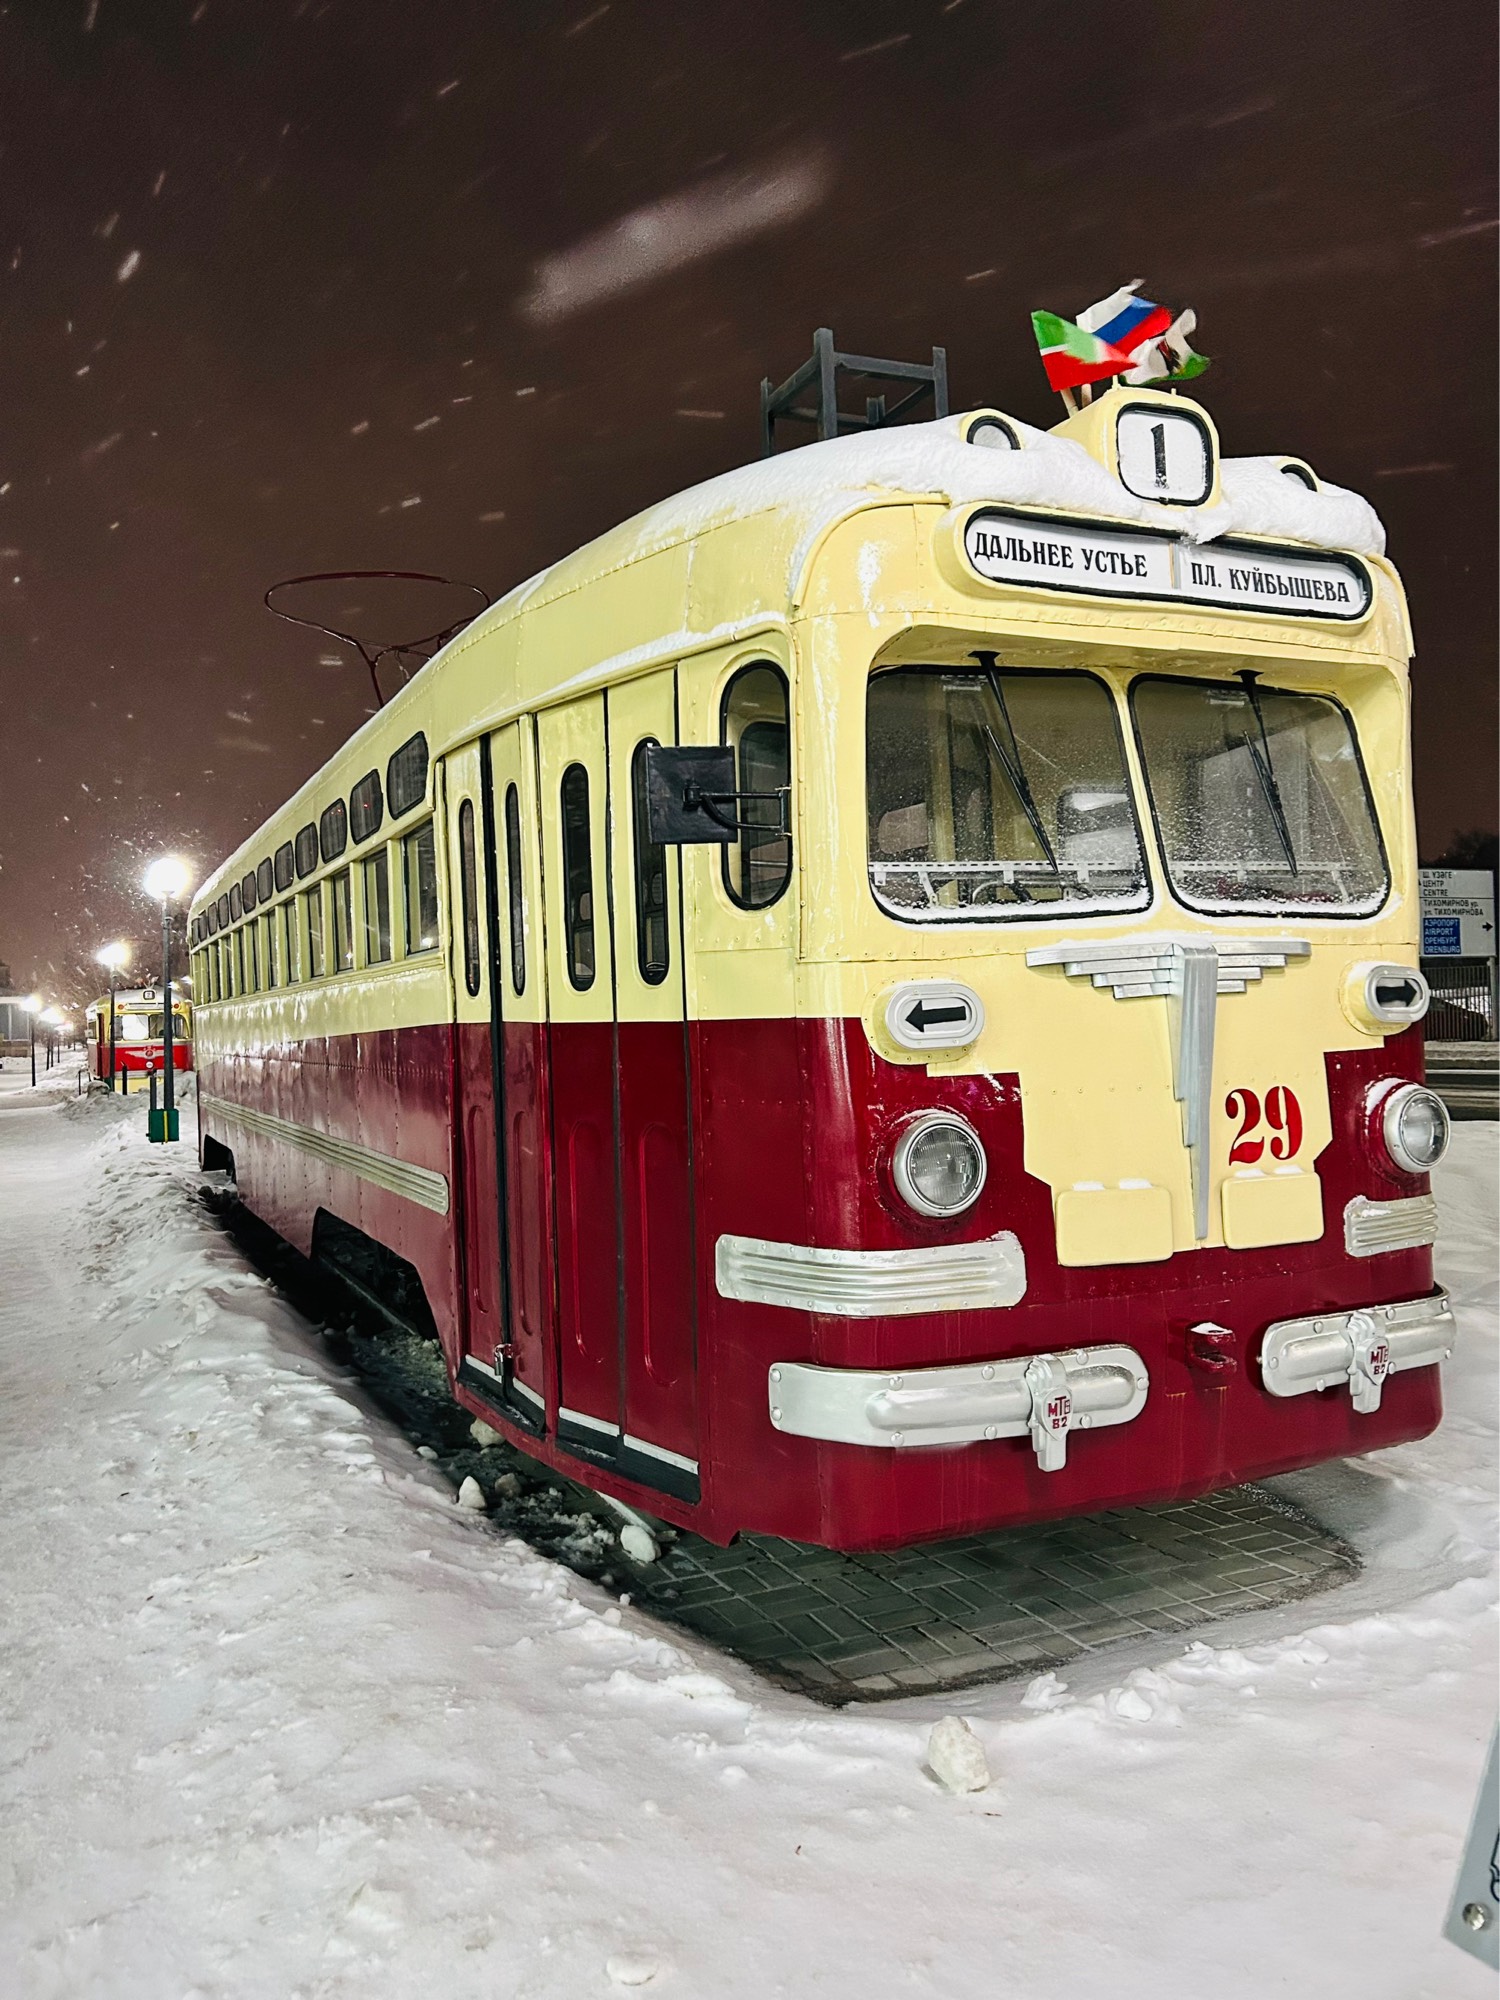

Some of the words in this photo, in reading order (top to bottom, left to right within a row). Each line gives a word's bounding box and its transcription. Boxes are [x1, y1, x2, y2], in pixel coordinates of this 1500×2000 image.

[1150, 423, 1169, 489] 1
[974, 532, 1074, 569] ДАЛЬНЕЕ
[1081, 548, 1148, 578] УСТЬЕ
[1191, 562, 1222, 588] ПЛ.
[1228, 567, 1351, 603] КУЙБЫШЕВА
[1423, 880, 1444, 888] ЦЕНТР
[1423, 889, 1448, 897] CENTRE
[1423, 899, 1469, 907] ТИХОМИРНОВ
[1434, 908, 1484, 916] ТИХОМИРНОВА
[1424, 945, 1460, 953] ORENBURG
[1225, 1085, 1303, 1166] 29
